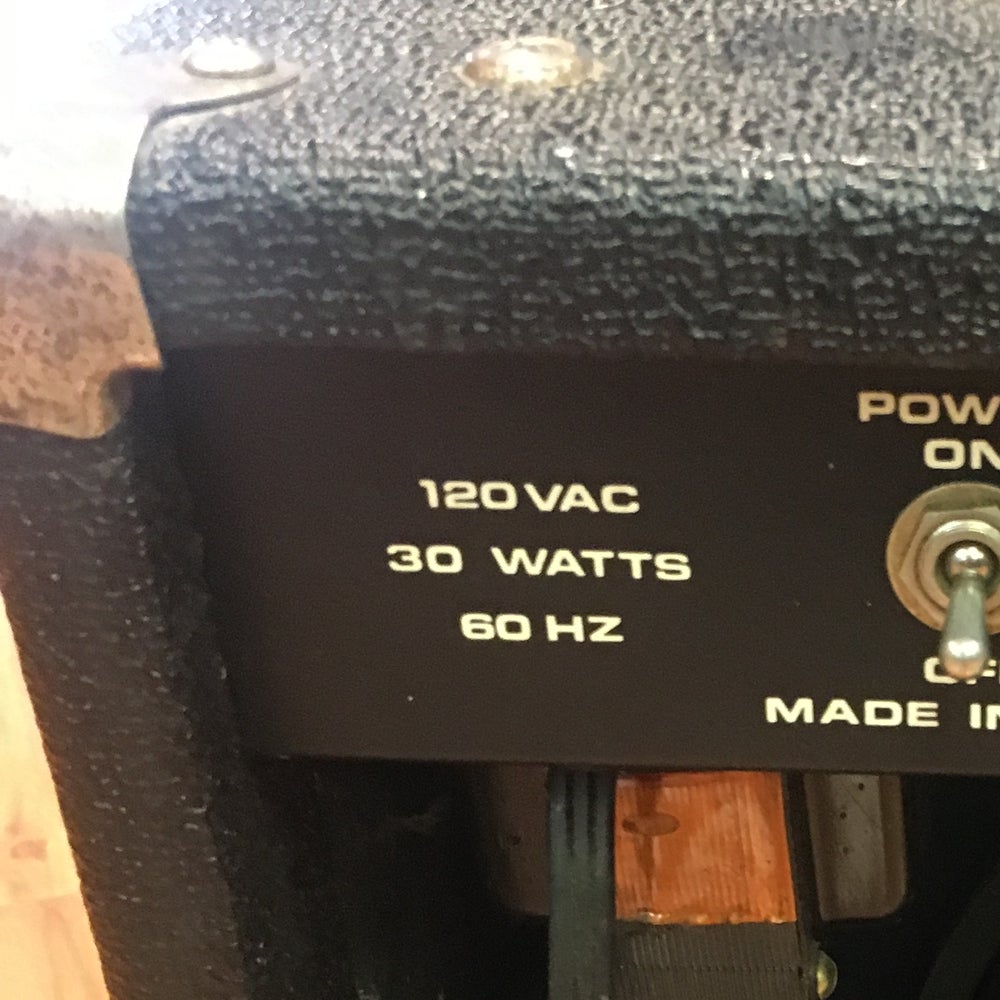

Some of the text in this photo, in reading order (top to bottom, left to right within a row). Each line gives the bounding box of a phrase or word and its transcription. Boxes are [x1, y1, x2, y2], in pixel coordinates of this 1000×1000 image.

[418, 479, 640, 514] 120 VAC
[386, 544, 692, 581] 30 WATTS
[460, 613, 624, 643] 60 HZ
[765, 697, 939, 727] MADE
